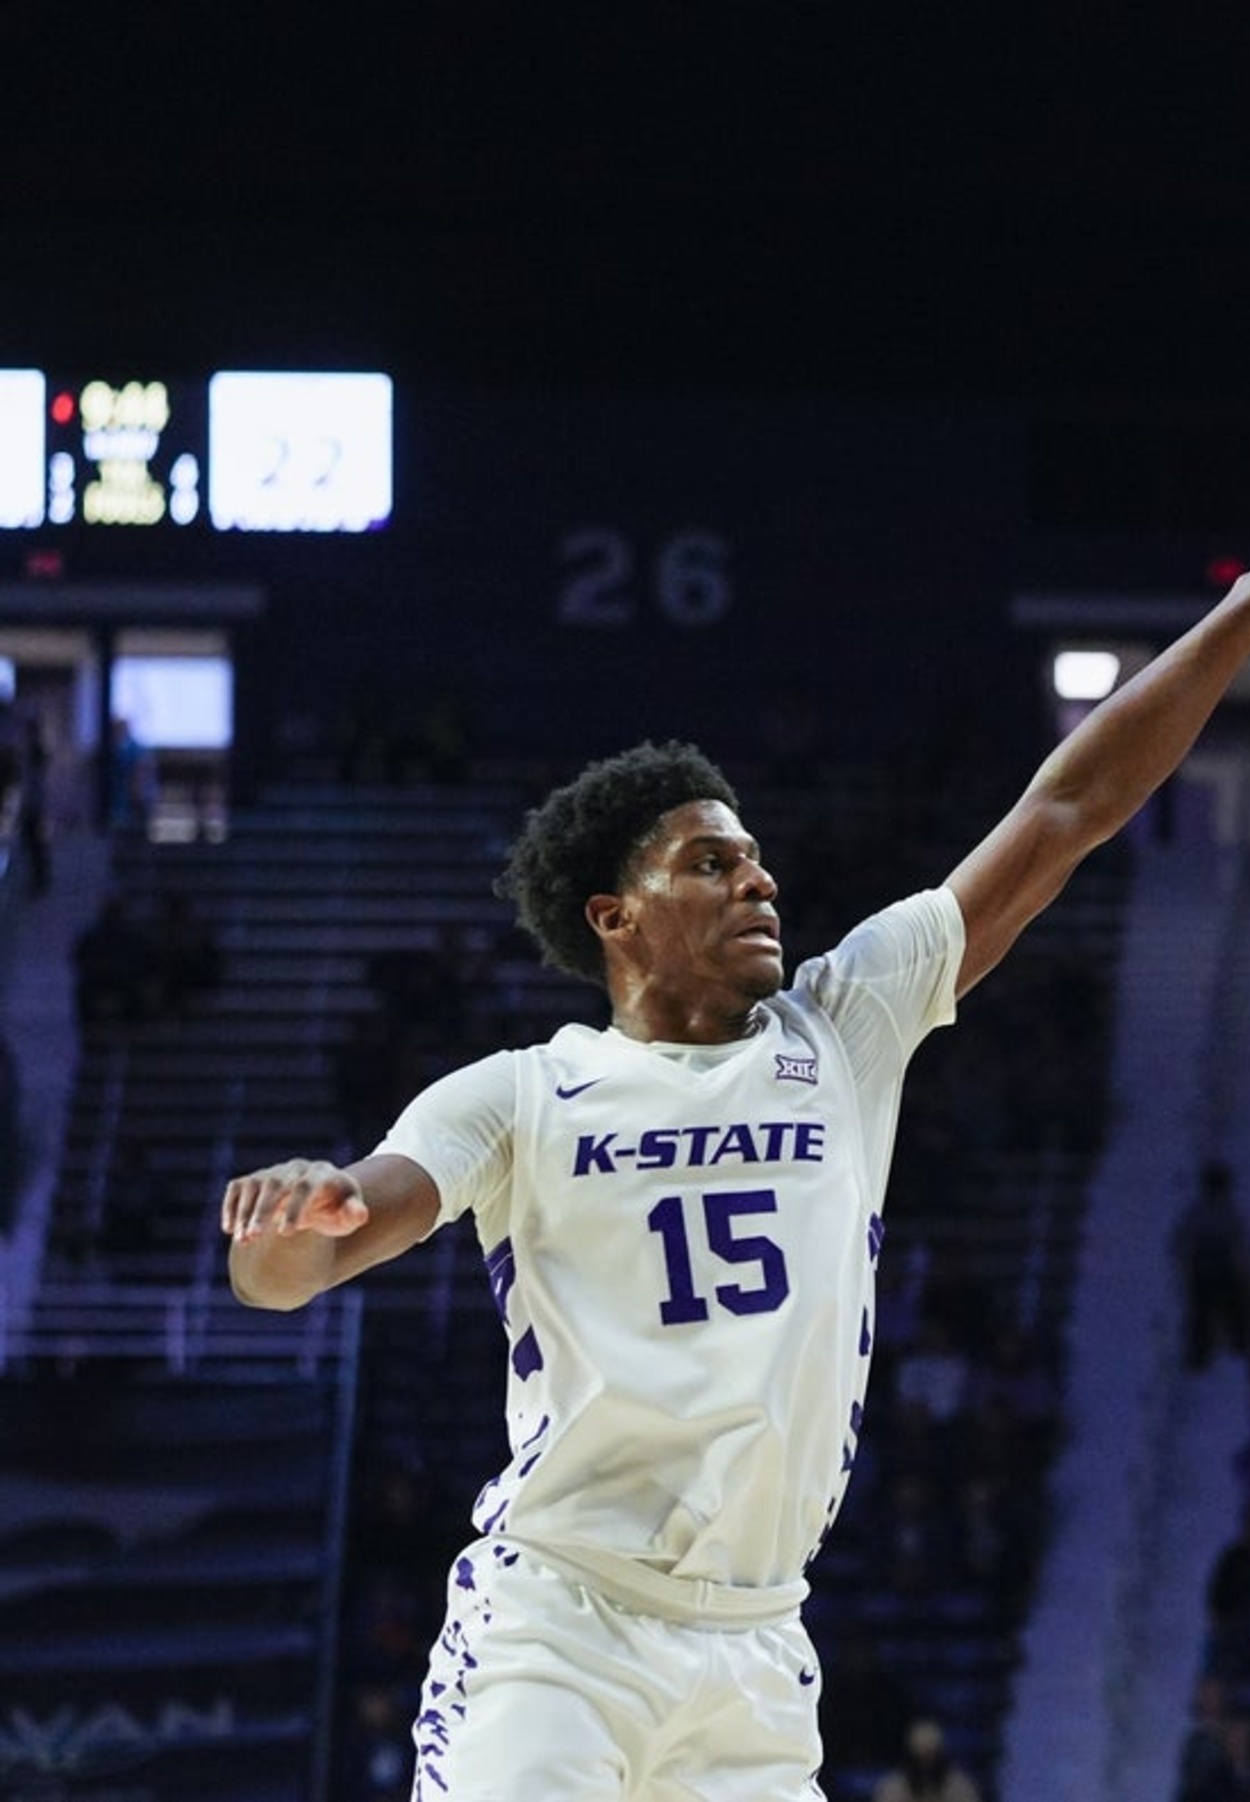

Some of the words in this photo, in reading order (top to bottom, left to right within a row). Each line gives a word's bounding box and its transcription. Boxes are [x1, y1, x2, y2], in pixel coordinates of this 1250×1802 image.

[556, 529, 733, 628] 26
[573, 1123, 824, 1177] K-STATE
[647, 1190, 790, 1325] 15
